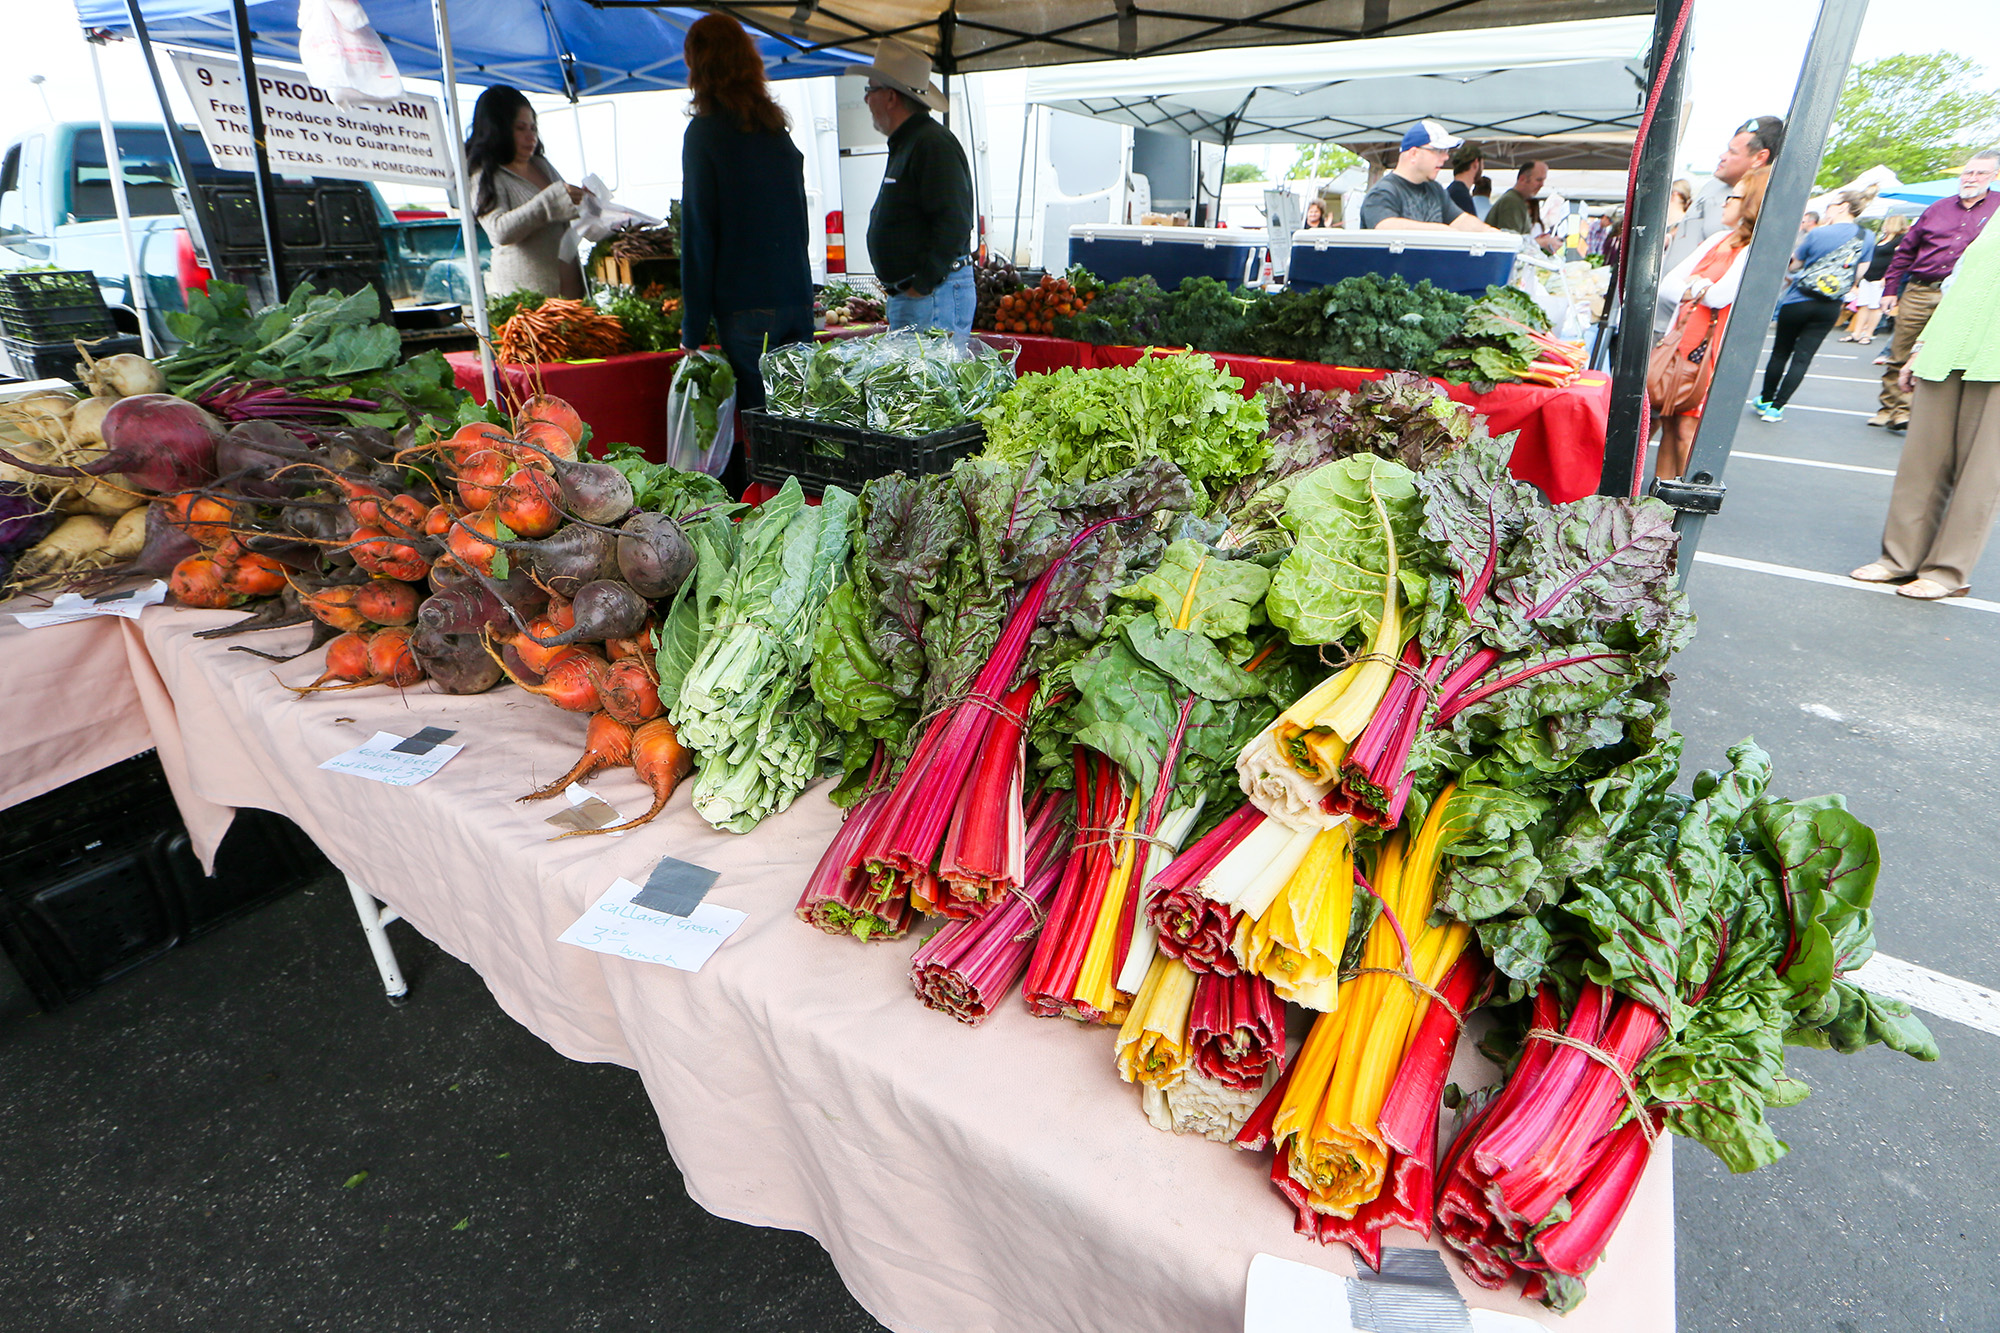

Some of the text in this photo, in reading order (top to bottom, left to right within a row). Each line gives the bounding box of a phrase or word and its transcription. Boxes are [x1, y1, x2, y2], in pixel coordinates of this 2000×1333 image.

[197, 67, 213, 86] 9
[209, 98, 431, 141] Fres Produce Straight From
[215, 118, 250, 135] The
[299, 127, 320, 142] To
[323, 130, 352, 146] You
[356, 135, 433, 158] Guaranteed
[277, 149, 324, 164] TEXAS
[336, 155, 369, 169] 100%
[372, 160, 447, 178] HOMEGROWN
[676, 919, 723, 937] Green
[619, 944, 678, 967] bunch
